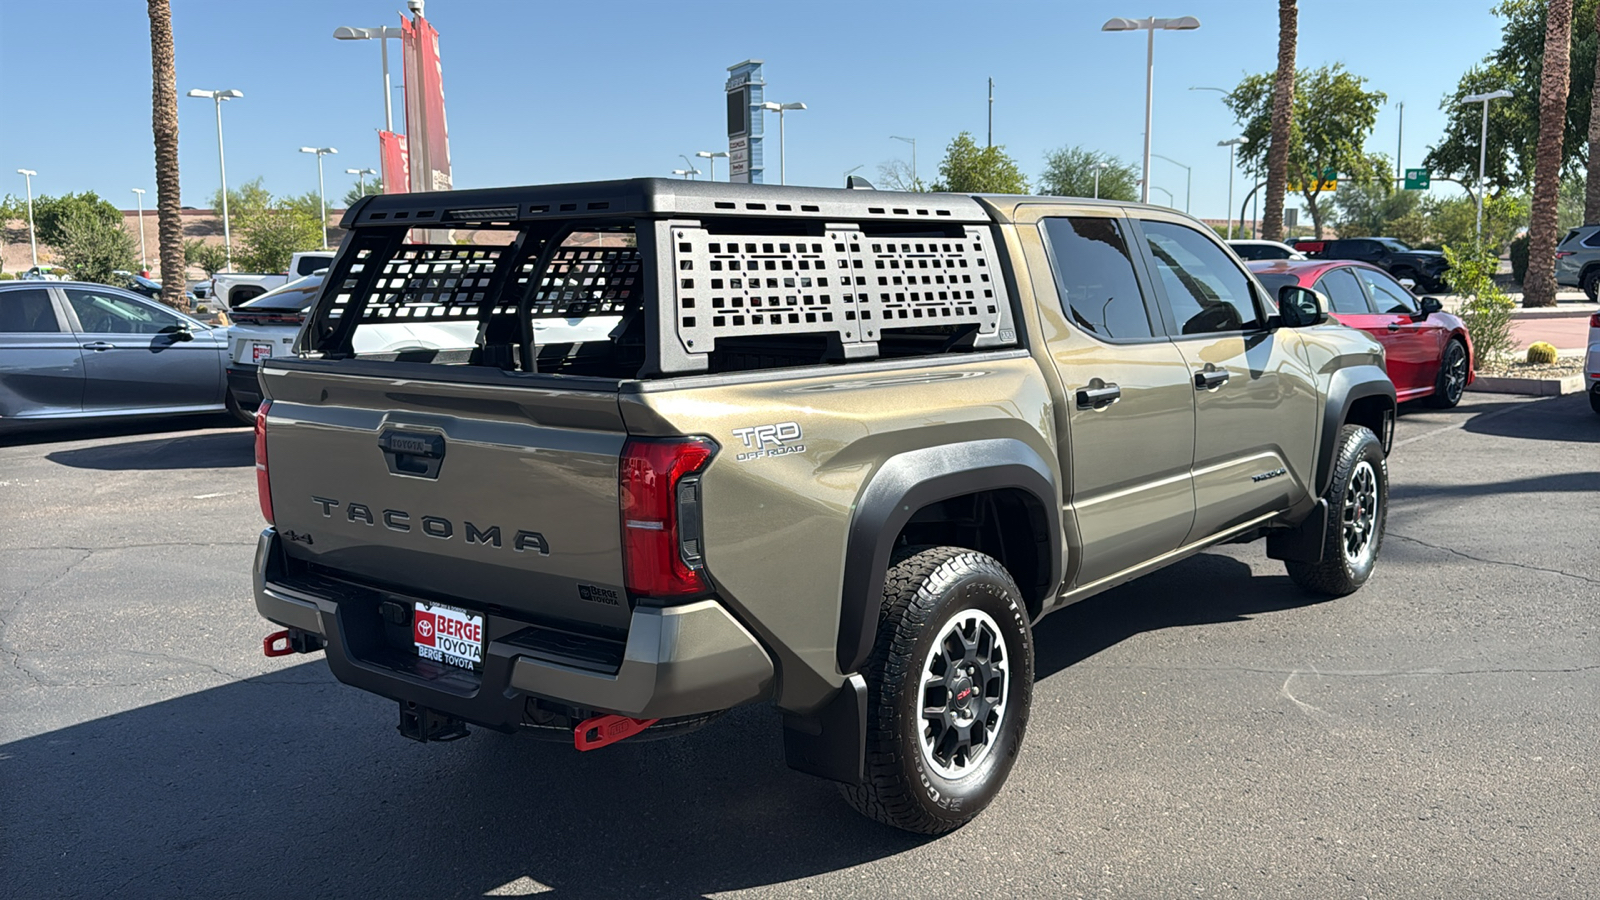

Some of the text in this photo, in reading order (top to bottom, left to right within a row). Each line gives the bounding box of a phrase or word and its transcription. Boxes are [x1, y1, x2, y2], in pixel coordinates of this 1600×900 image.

[392, 438, 426, 452] TOYOTA
[732, 421, 803, 450] TRD
[736, 444, 807, 462] OFF ROAD
[311, 495, 550, 556] TACOMA
[590, 585, 618, 600] BERGE
[592, 595, 620, 607] TOYOTA
[437, 614, 481, 642] BERGE
[418, 645, 474, 671] BERGE TOYOTA
[437, 636, 481, 659] TOYOTA
